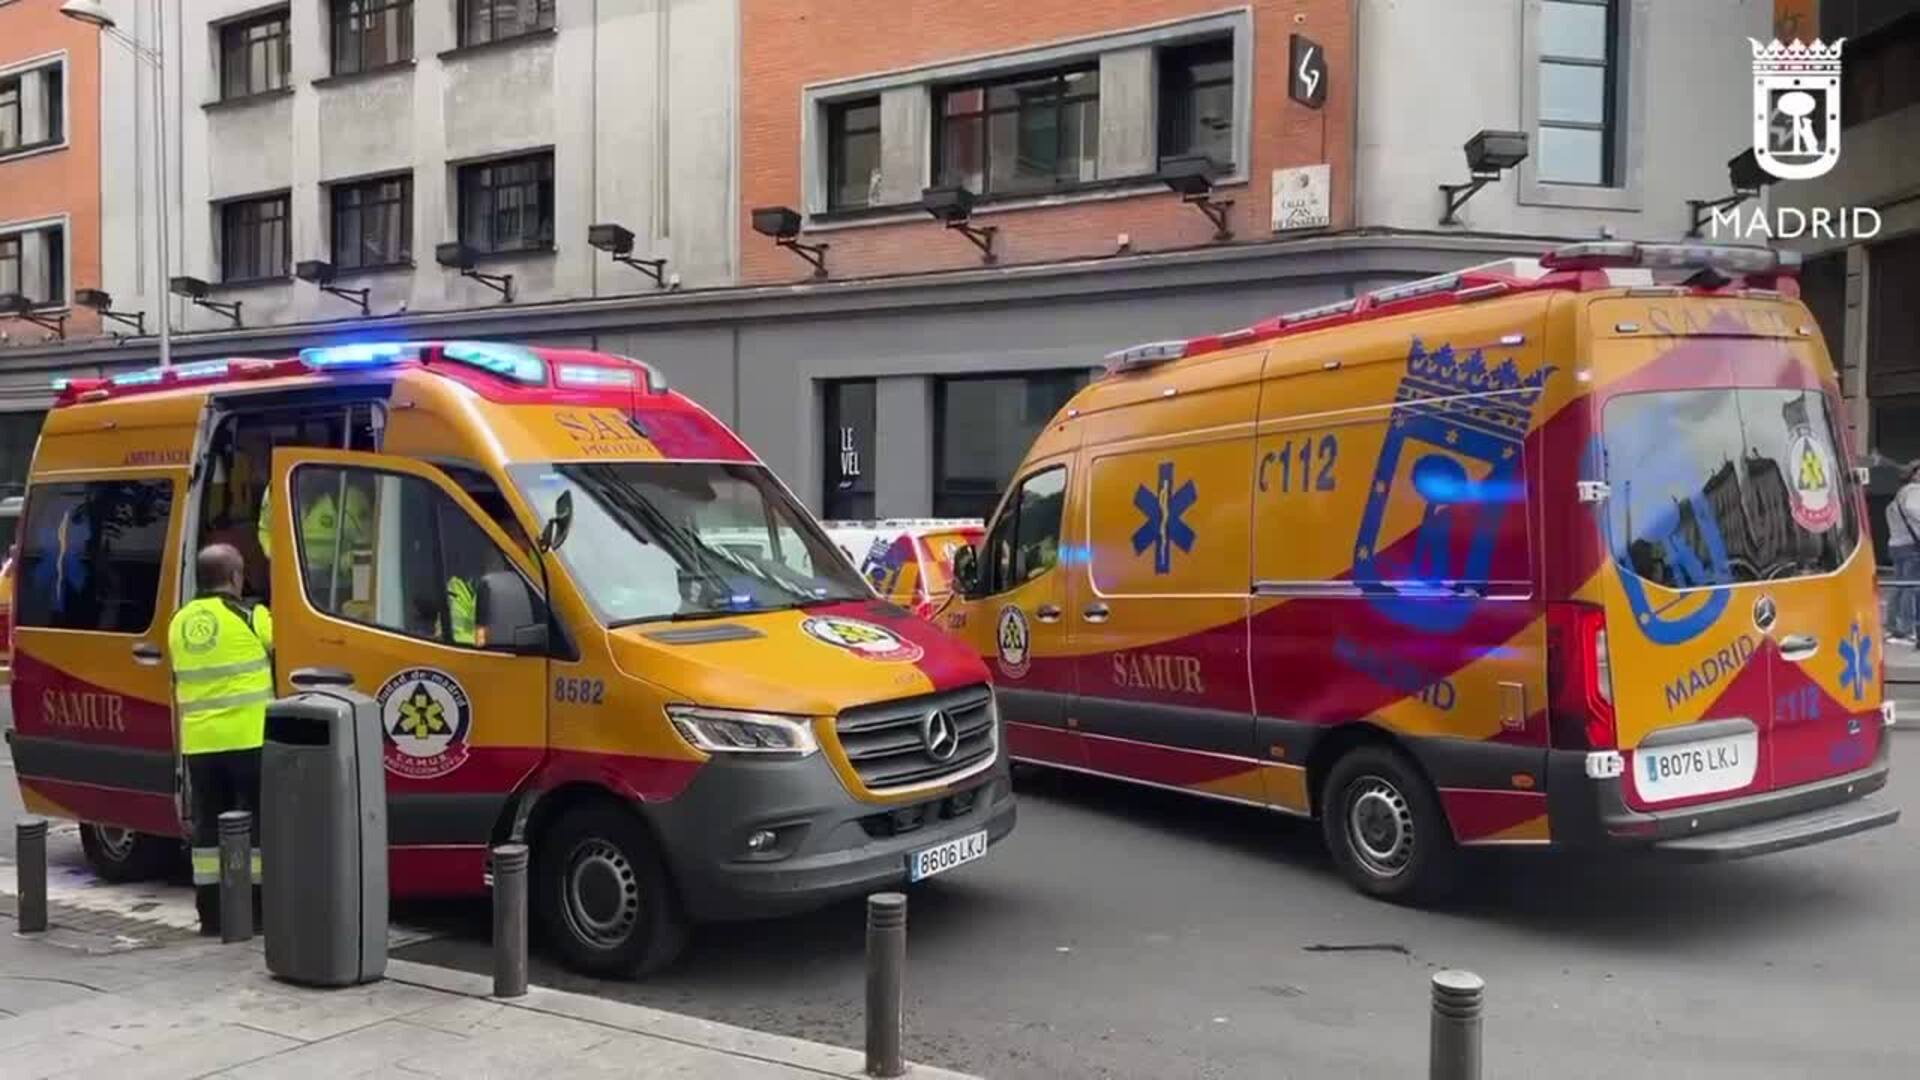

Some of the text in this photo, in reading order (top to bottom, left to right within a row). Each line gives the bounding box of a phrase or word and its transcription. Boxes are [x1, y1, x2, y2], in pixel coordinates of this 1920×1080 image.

[841, 427, 853, 451] LE
[841, 452, 860, 475] VEL
[554, 677, 604, 705] 8582
[1113, 652, 1206, 694] SAMUR
[1664, 635, 1754, 713] MADRID
[42, 688, 125, 733] SAMUR
[1660, 743, 1739, 777] 8076 LKJ
[921, 833, 985, 875] 8606 LKJ
